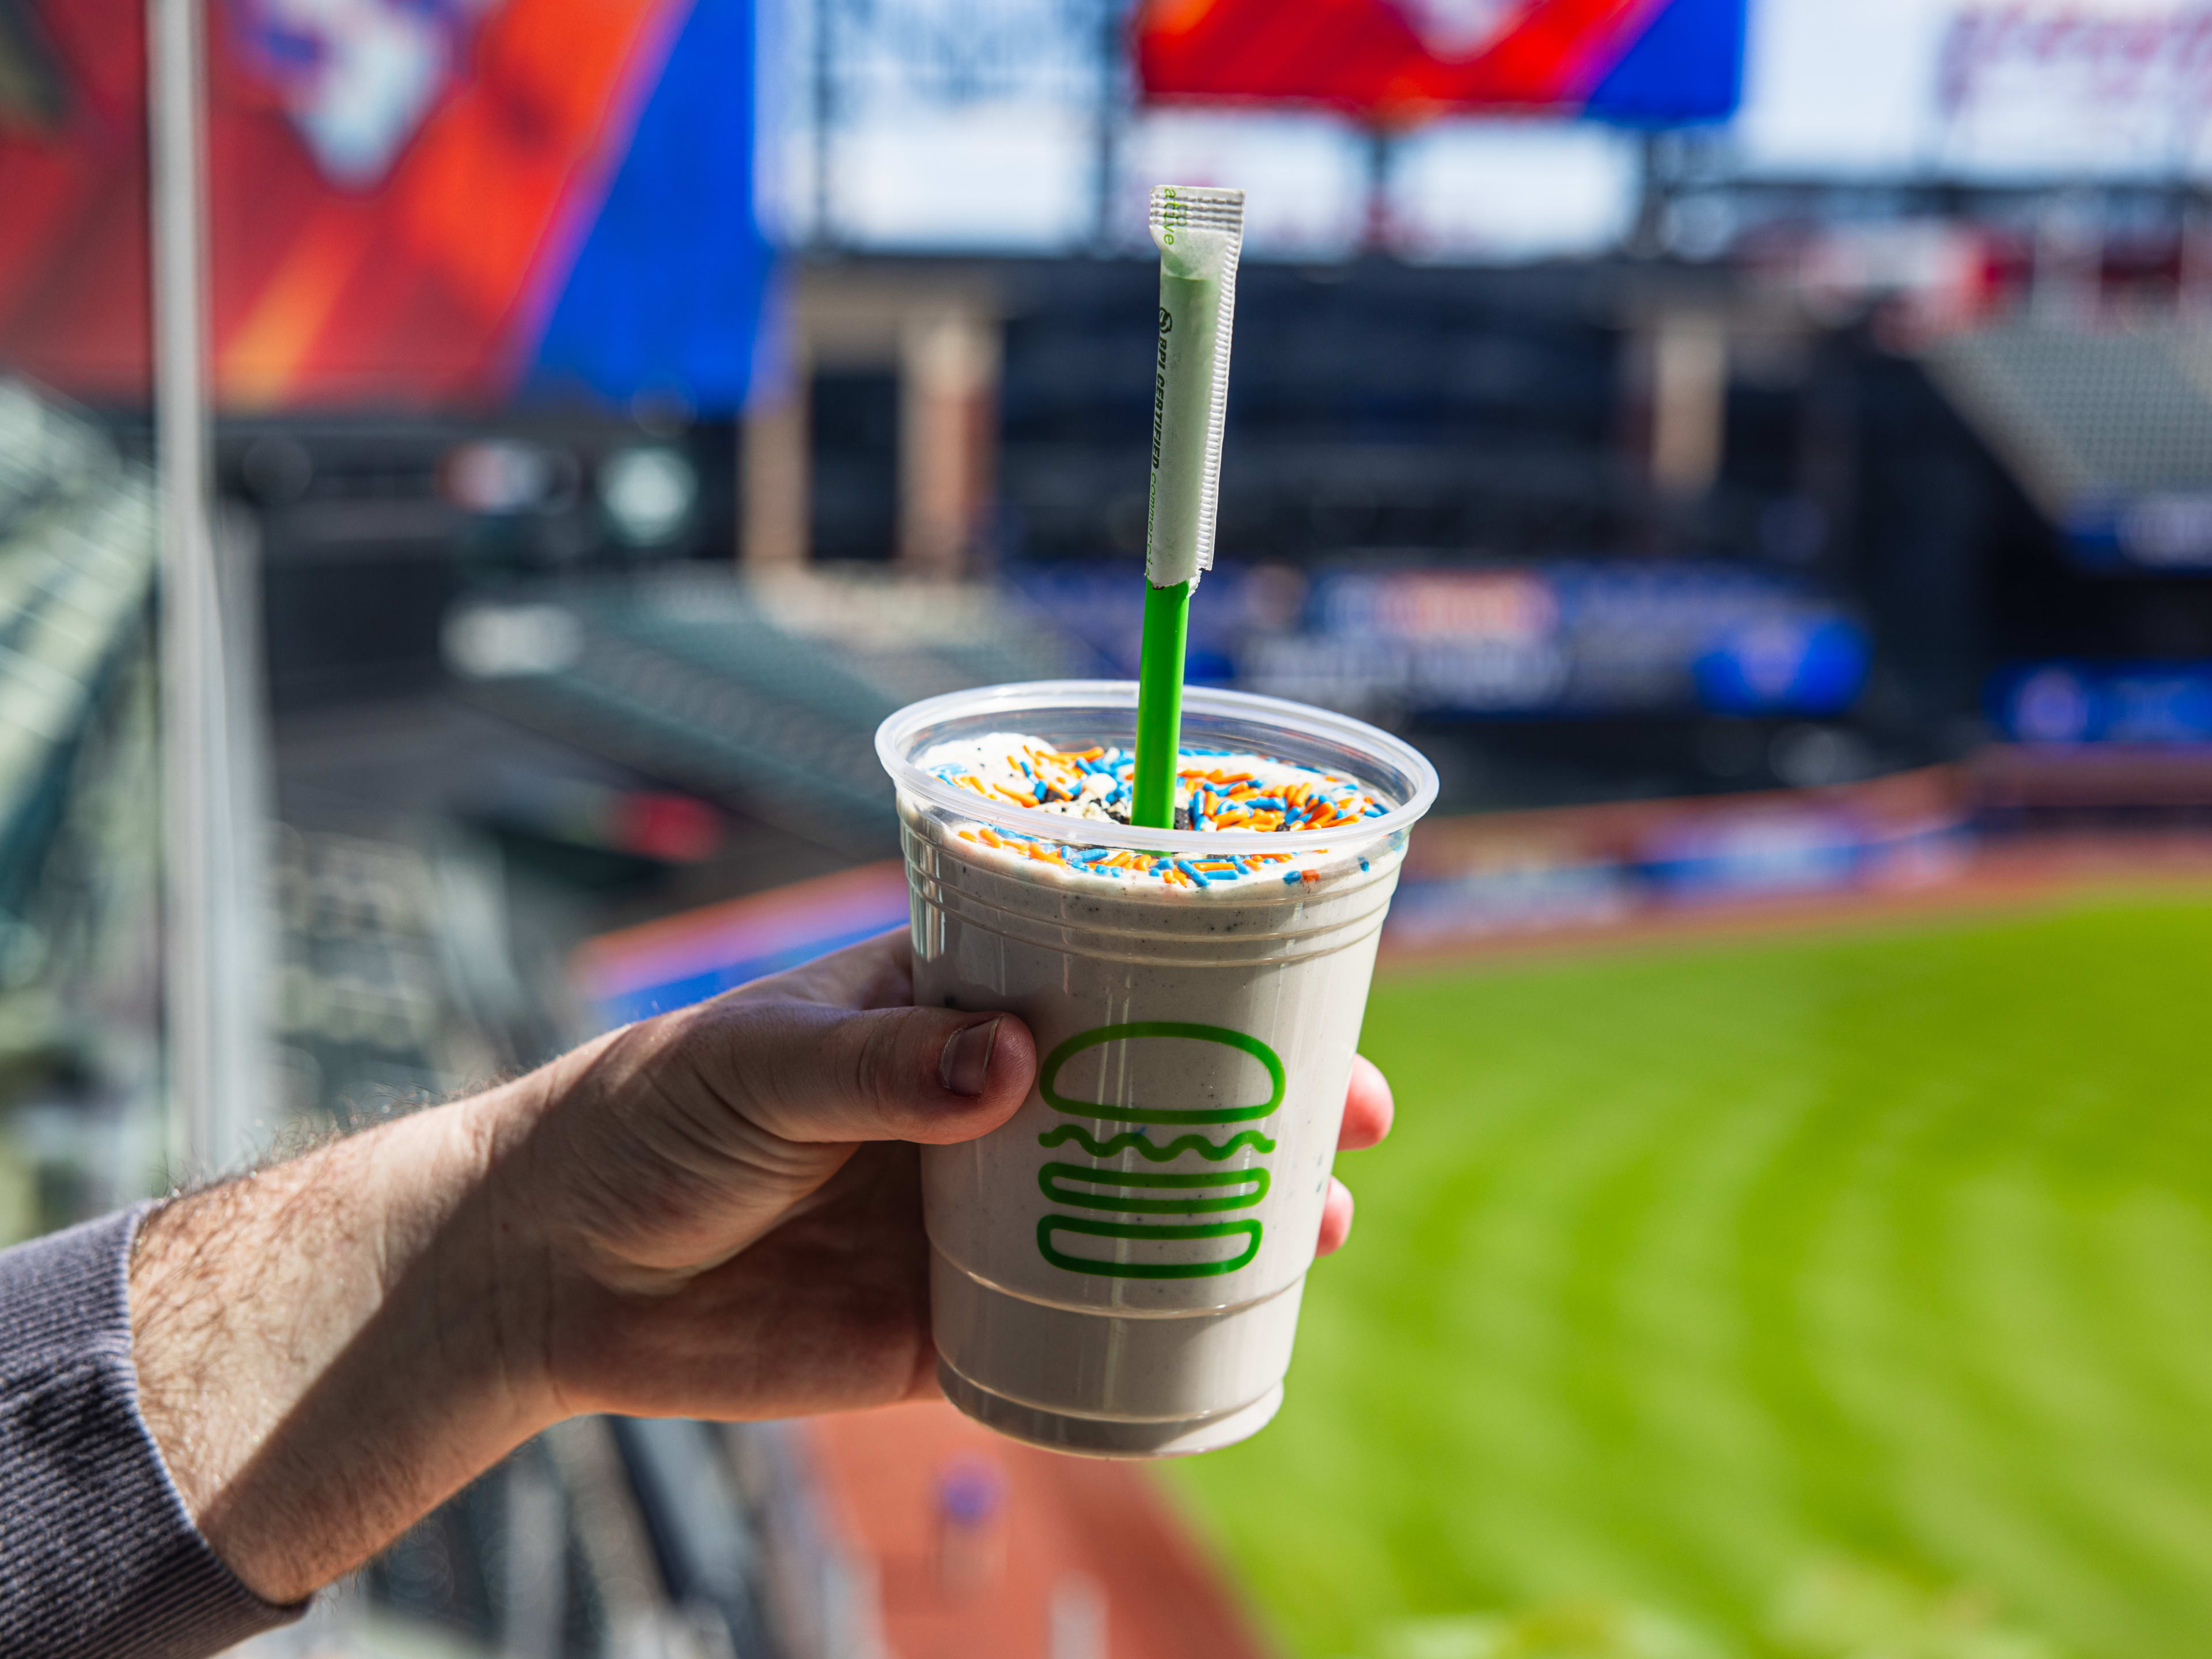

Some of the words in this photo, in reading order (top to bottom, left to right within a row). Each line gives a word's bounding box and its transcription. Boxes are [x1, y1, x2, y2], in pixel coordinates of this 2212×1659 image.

[1164, 188, 1179, 245] ative
[1158, 336, 1167, 370] BPI
[1153, 373, 1165, 469] CERTIFIED
